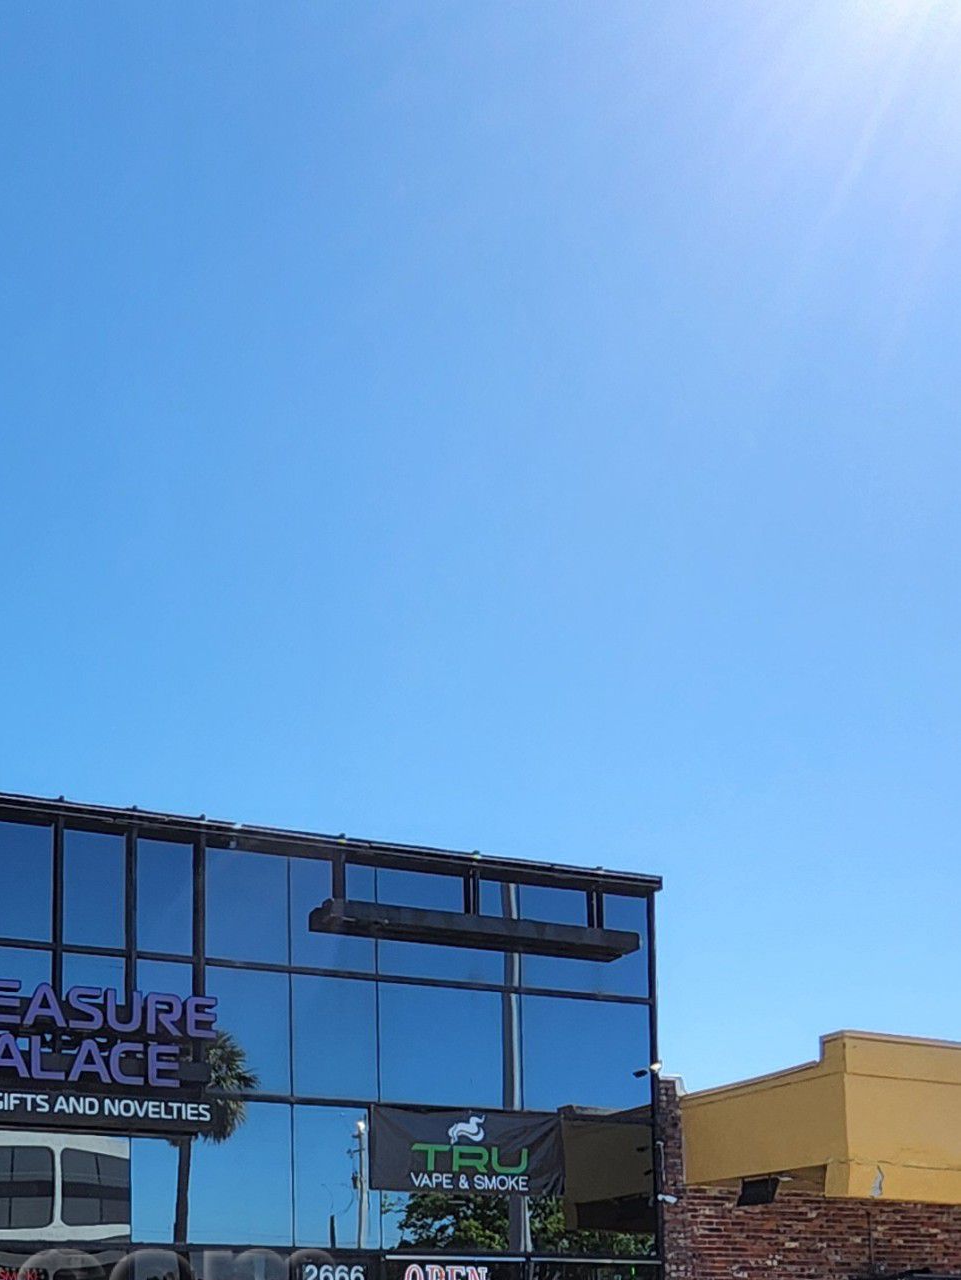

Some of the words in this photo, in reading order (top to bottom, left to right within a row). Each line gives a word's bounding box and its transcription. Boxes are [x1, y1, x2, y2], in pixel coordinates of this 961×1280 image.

[53, 1095, 99, 1116] AND
[103, 1098, 212, 1122] NOVELTIES
[410, 1142, 529, 1174] TRU
[410, 1171, 454, 1189] VAPE
[458, 1175, 470, 1190] &
[473, 1175, 529, 1191] SMOKE
